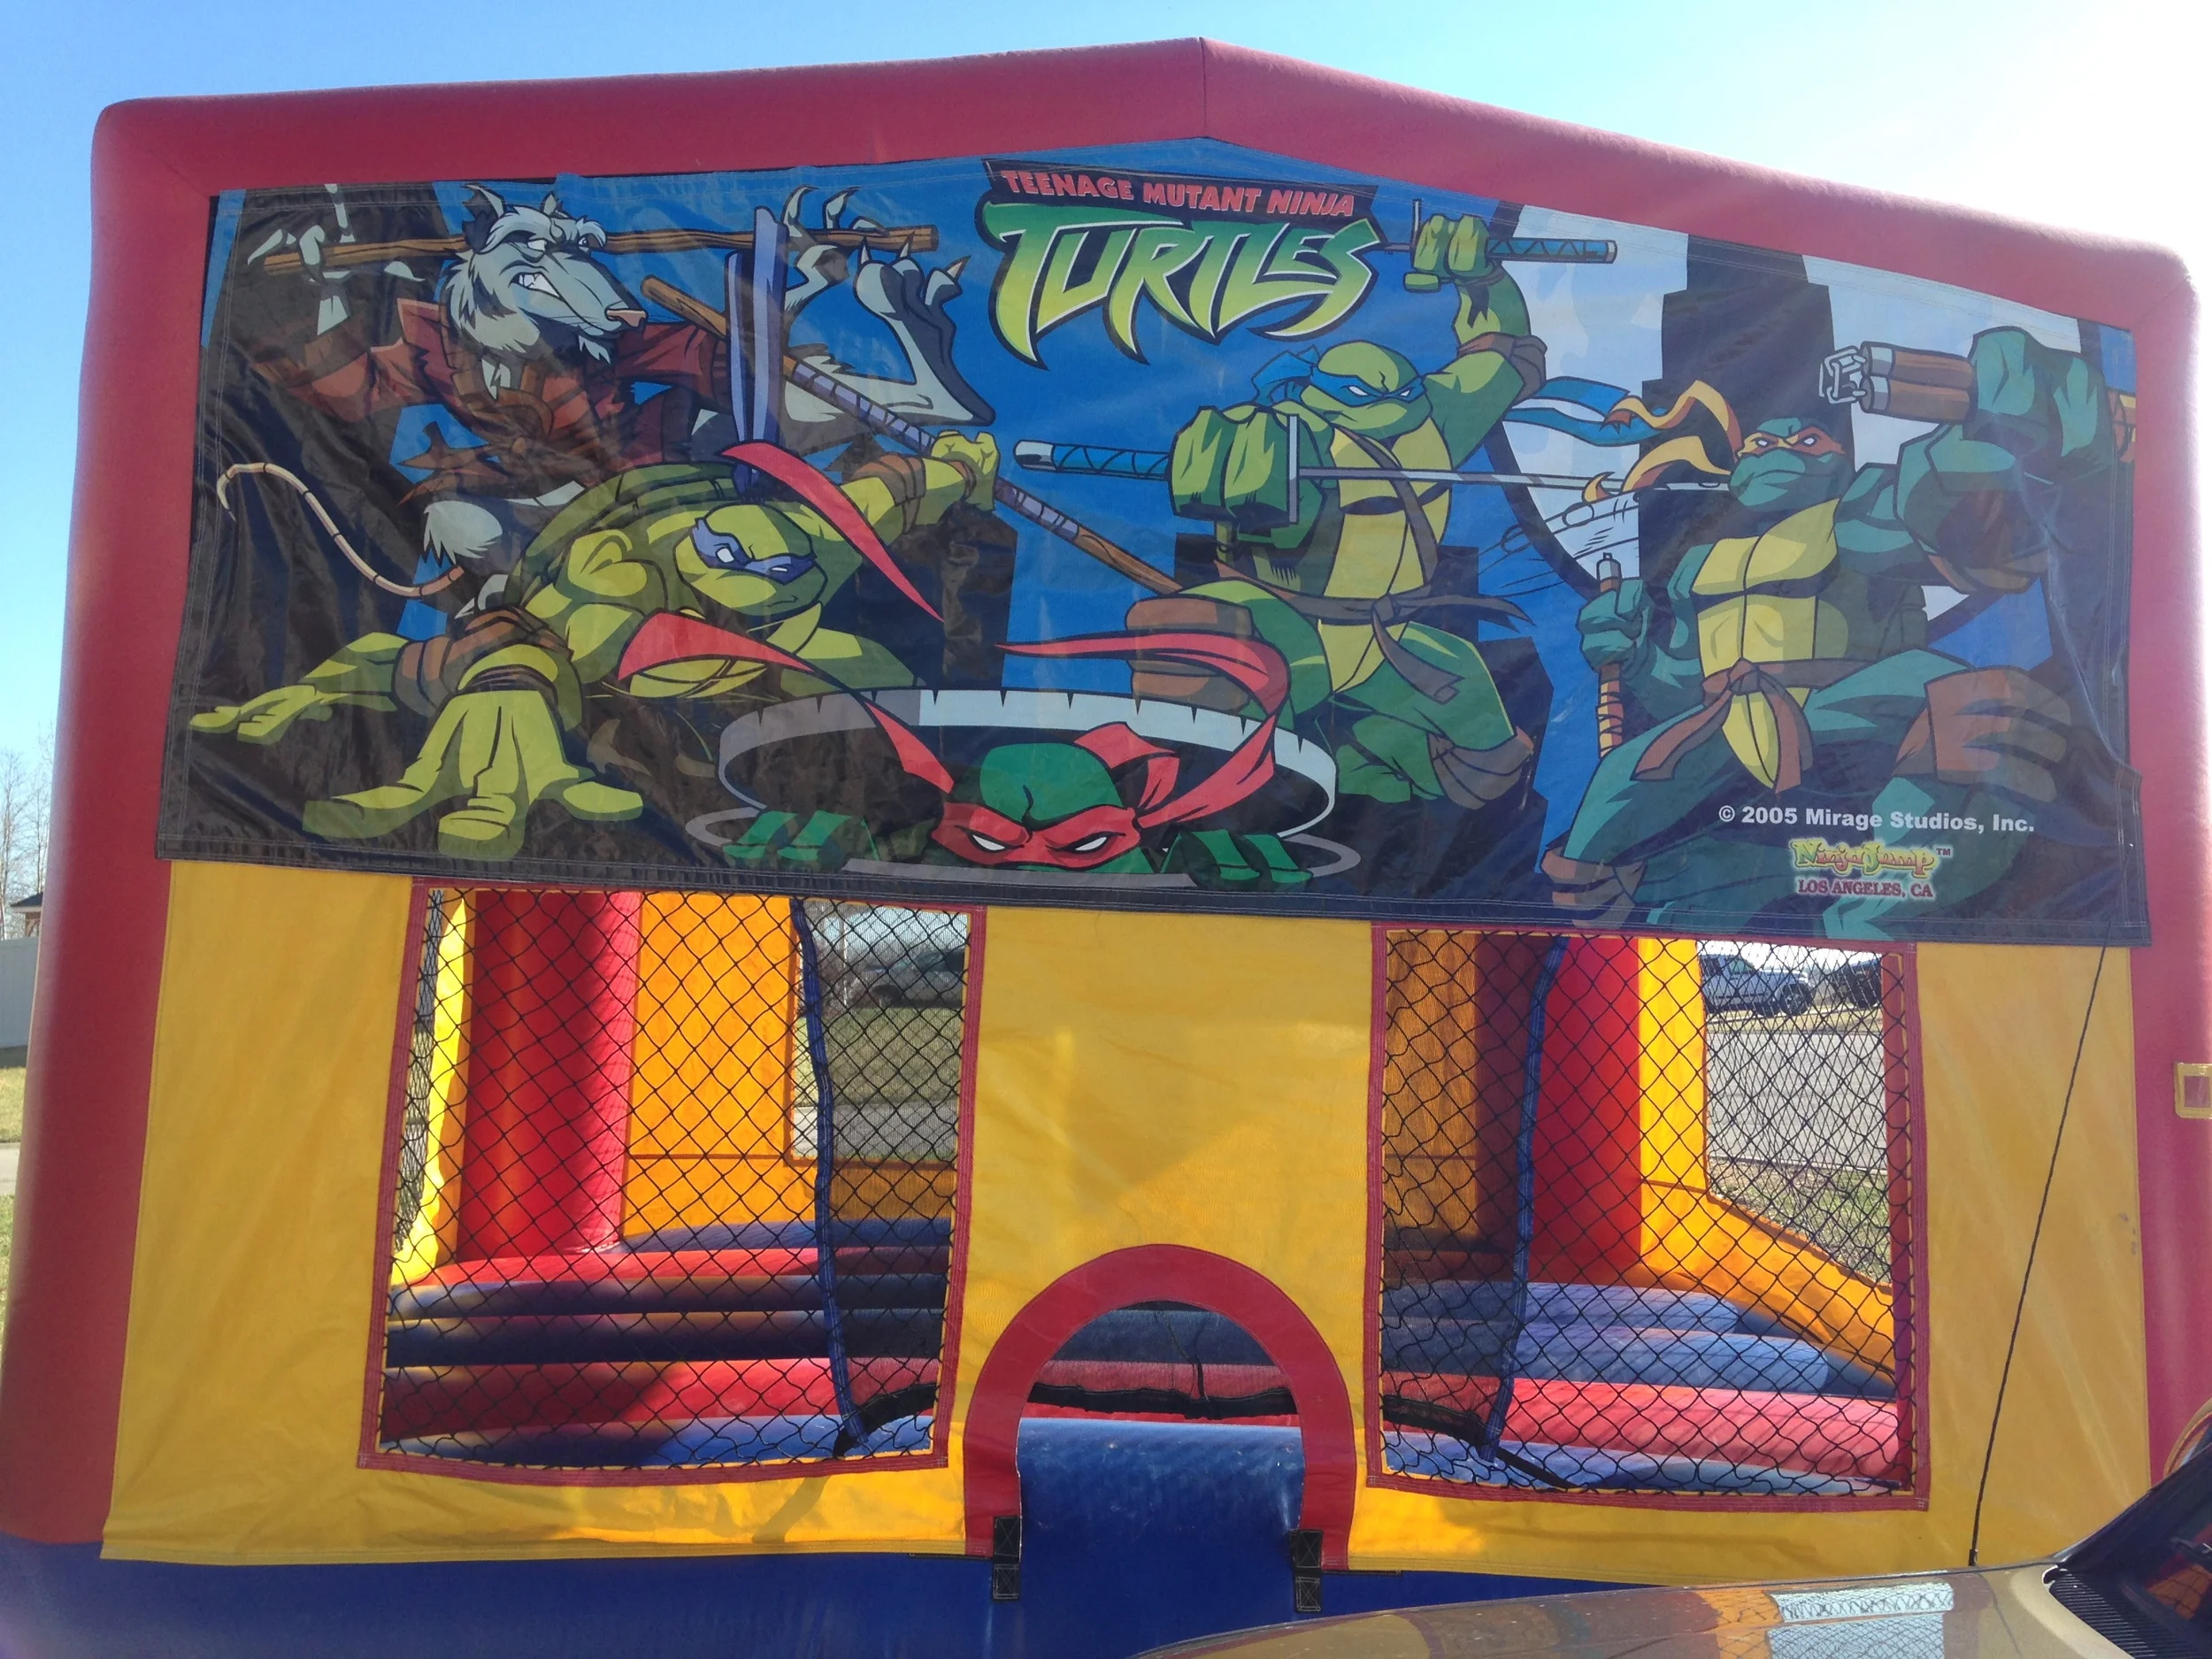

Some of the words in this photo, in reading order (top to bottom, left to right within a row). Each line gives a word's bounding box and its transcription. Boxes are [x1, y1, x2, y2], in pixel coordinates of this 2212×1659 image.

[1002, 171, 1135, 200] TEENAGE
[1143, 183, 1261, 212] MUTANT
[1267, 188, 1356, 218] NINJA
[982, 202, 1381, 362] TURTLES
[1742, 806, 1798, 825] 2005
[1806, 810, 1883, 830] Mirage
[1890, 811, 1985, 834] Studios,
[1993, 814, 2035, 832] Inc.
[1798, 879, 1829, 895] LOS
[1832, 879, 1906, 897] ANGELES,
[1910, 883, 1933, 897] CA
